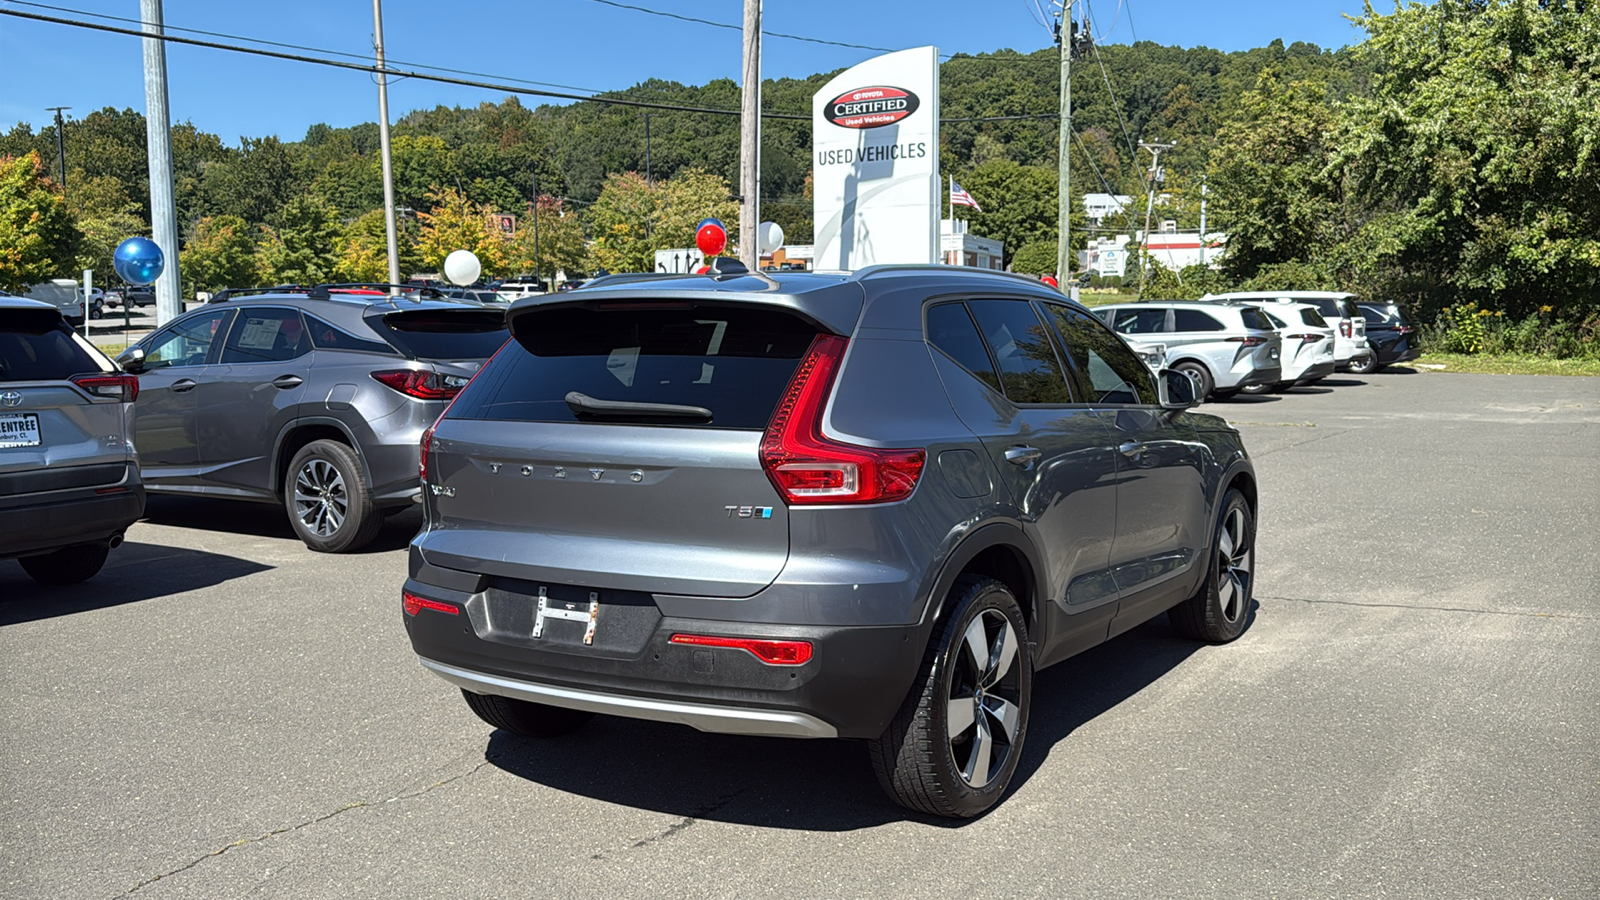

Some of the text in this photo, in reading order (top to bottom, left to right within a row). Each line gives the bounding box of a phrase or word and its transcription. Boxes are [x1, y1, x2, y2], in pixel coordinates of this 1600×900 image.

[861, 90, 884, 99] TOYOTA
[834, 99, 908, 117] CERTIFIED
[845, 115, 896, 126] Used Vehicles
[819, 142, 926, 166] USED VEHICLES
[0, 419, 36, 433] ENTREE
[489, 461, 646, 483] VOLVO
